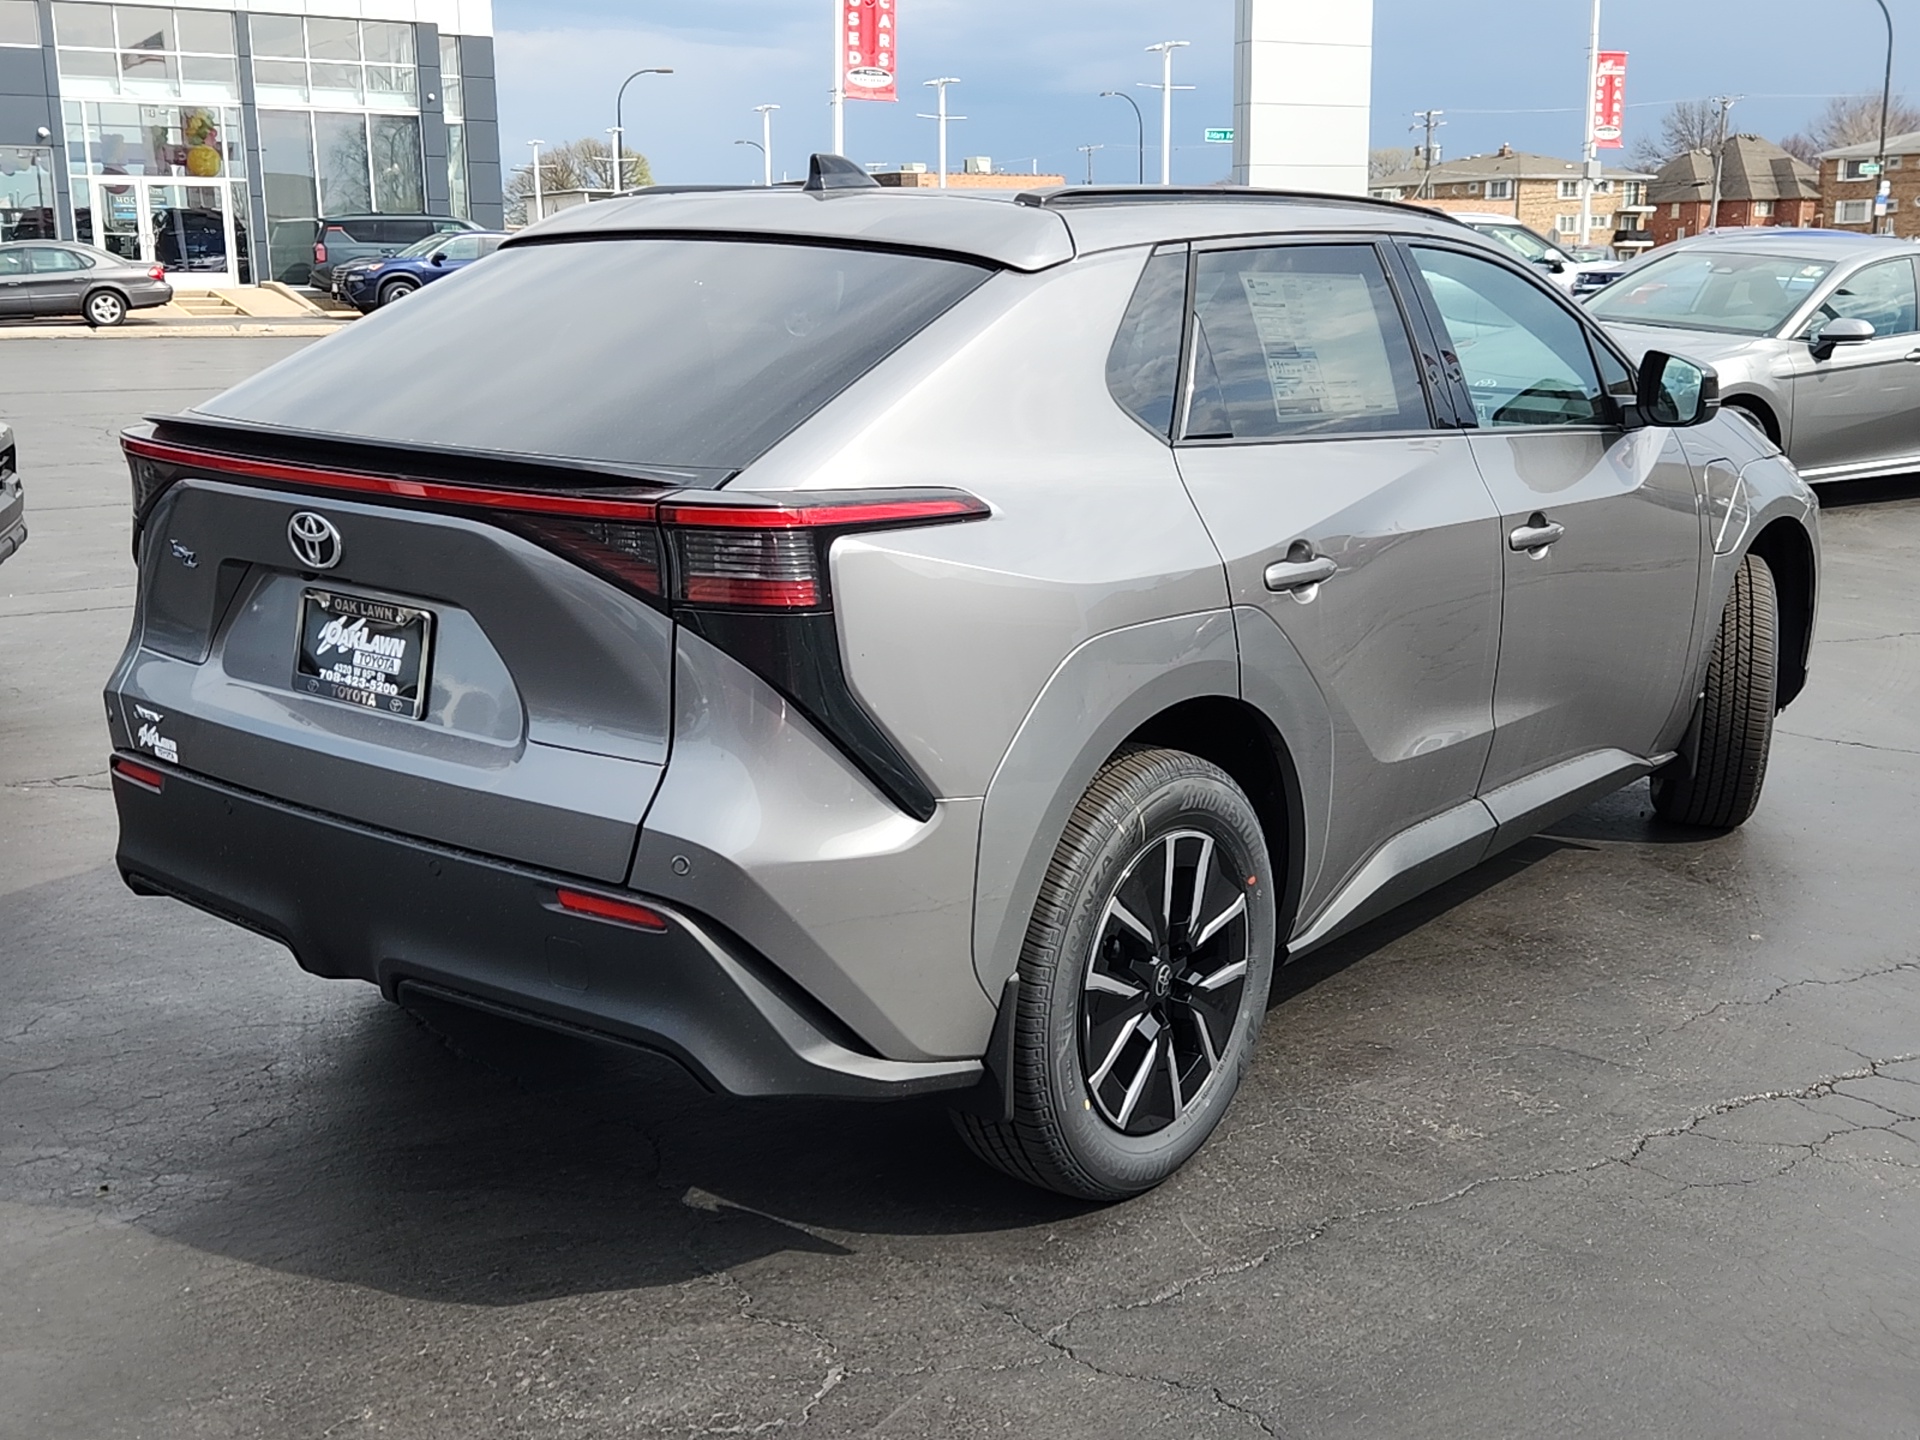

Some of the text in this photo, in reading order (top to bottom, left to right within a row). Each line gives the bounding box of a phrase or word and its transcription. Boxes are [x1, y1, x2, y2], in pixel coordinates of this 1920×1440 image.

[878, 0, 891, 66] CARS
[1596, 77, 1606, 125] USED
[1612, 78, 1622, 125] CARS
[334, 598, 394, 621] OAK LAWN
[358, 653, 395, 671] TOYOTA
[319, 668, 399, 696] 708-423-5200
[331, 684, 377, 708] TOYOTA
[1179, 784, 1265, 868] BRIDGESTONE
